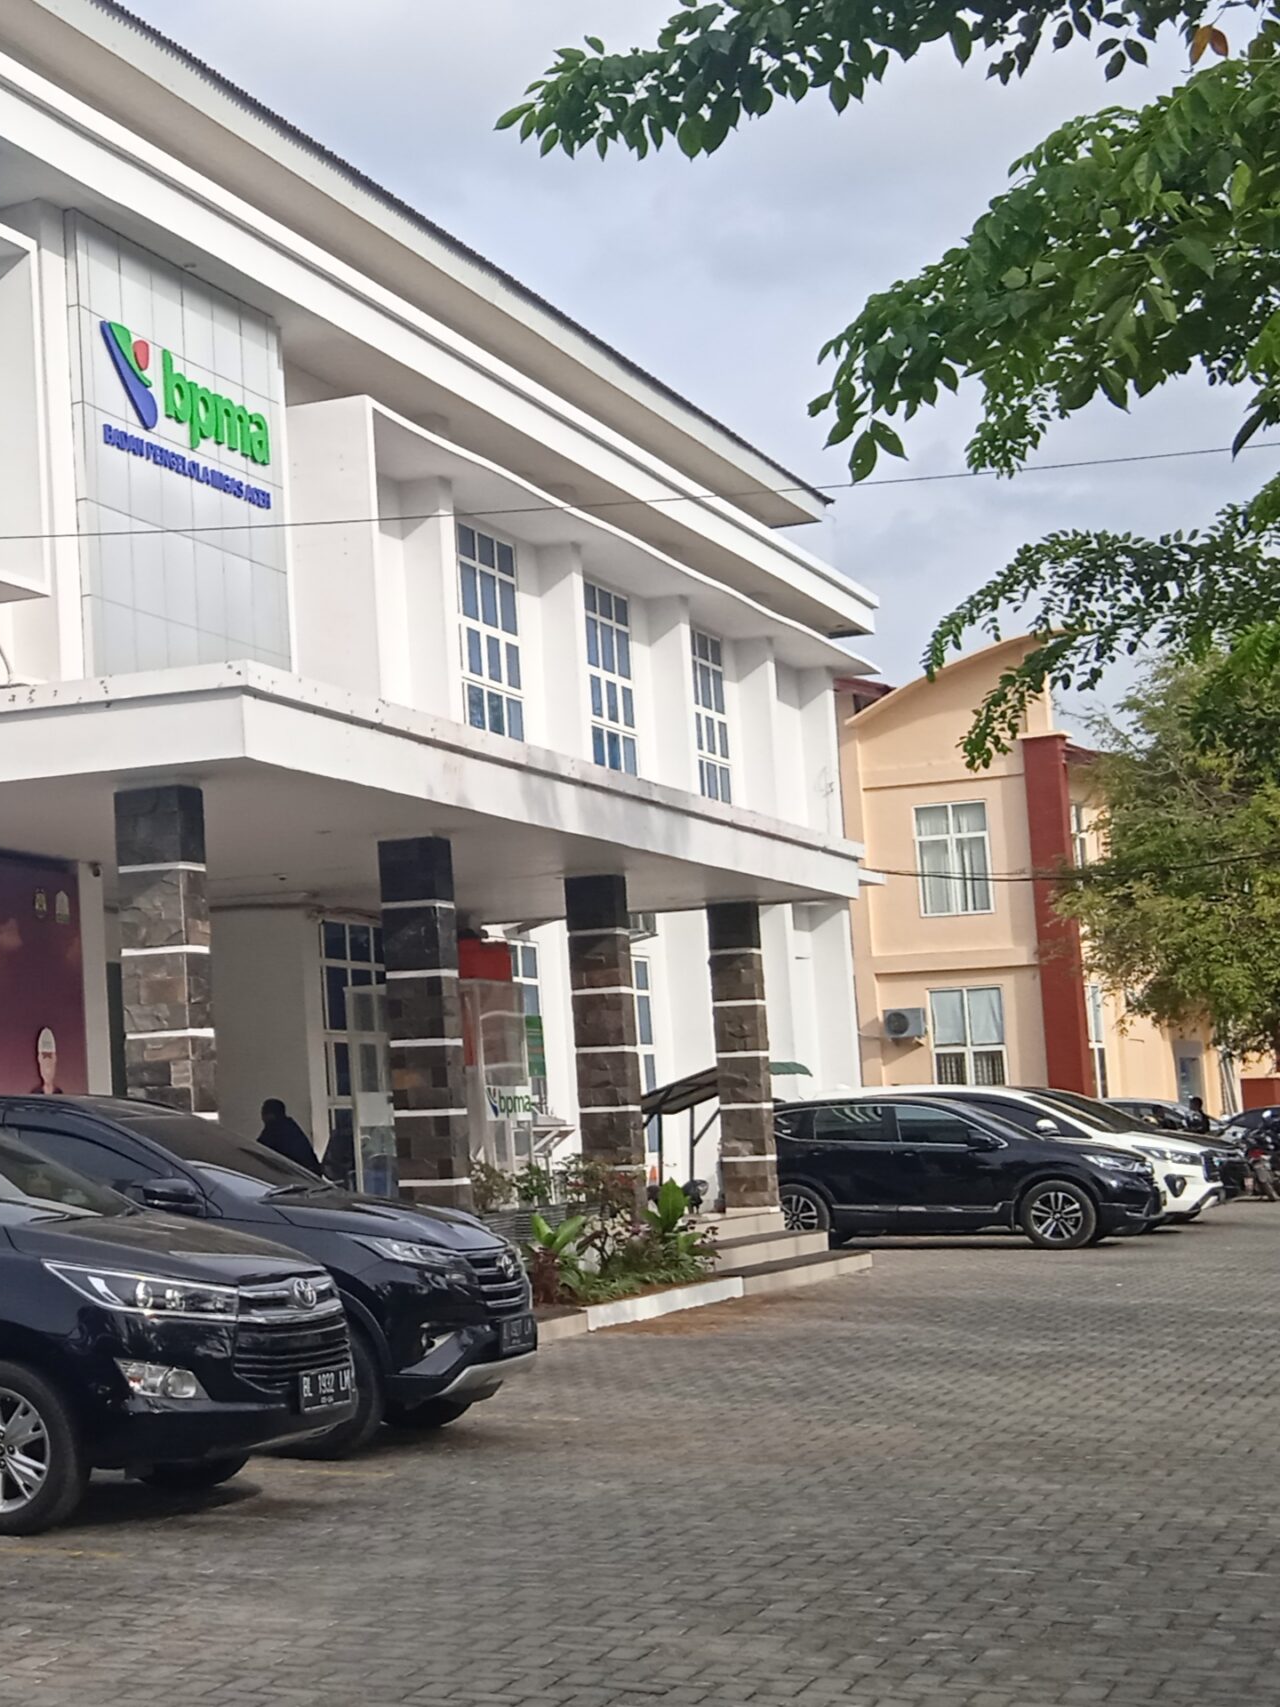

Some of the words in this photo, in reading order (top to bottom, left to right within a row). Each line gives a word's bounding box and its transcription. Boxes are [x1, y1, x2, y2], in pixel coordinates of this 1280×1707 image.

[162, 348, 270, 465] bpma
[102, 423, 145, 457] BADAN
[145, 441, 210, 486] PENGELOLA
[498, 1088, 531, 1119] bpma
